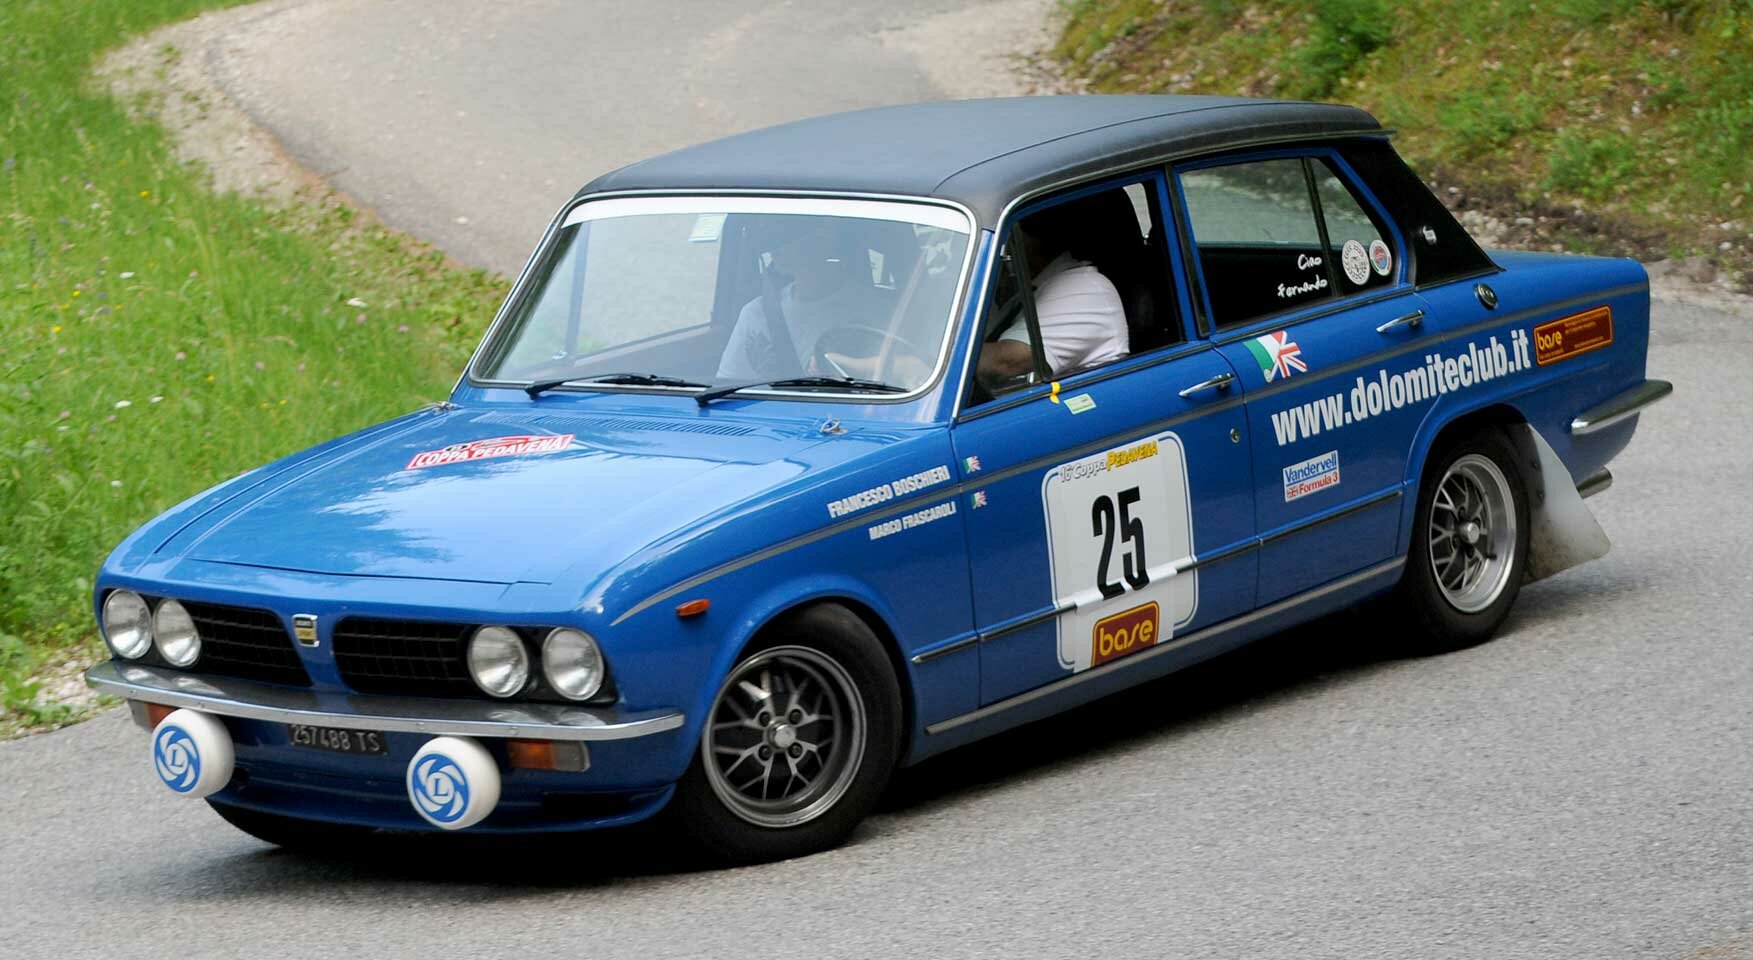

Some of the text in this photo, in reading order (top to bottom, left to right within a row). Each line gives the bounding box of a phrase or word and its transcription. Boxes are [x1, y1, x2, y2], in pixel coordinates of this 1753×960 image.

[1537, 331, 1562, 350] base
[1271, 329, 1531, 446] www.dolomiteclub.it
[415, 437, 563, 466] COPPA PEDAVENA
[1285, 452, 1336, 482] Vandervell
[827, 465, 950, 518] FRANCESCO BOSCHIERI
[1299, 471, 1338, 494] Formula 3
[868, 501, 956, 540] MARCO FRASCAROLI
[1092, 486, 1149, 600] 25
[1100, 619, 1153, 656] base
[355, 732, 380, 751] TS
